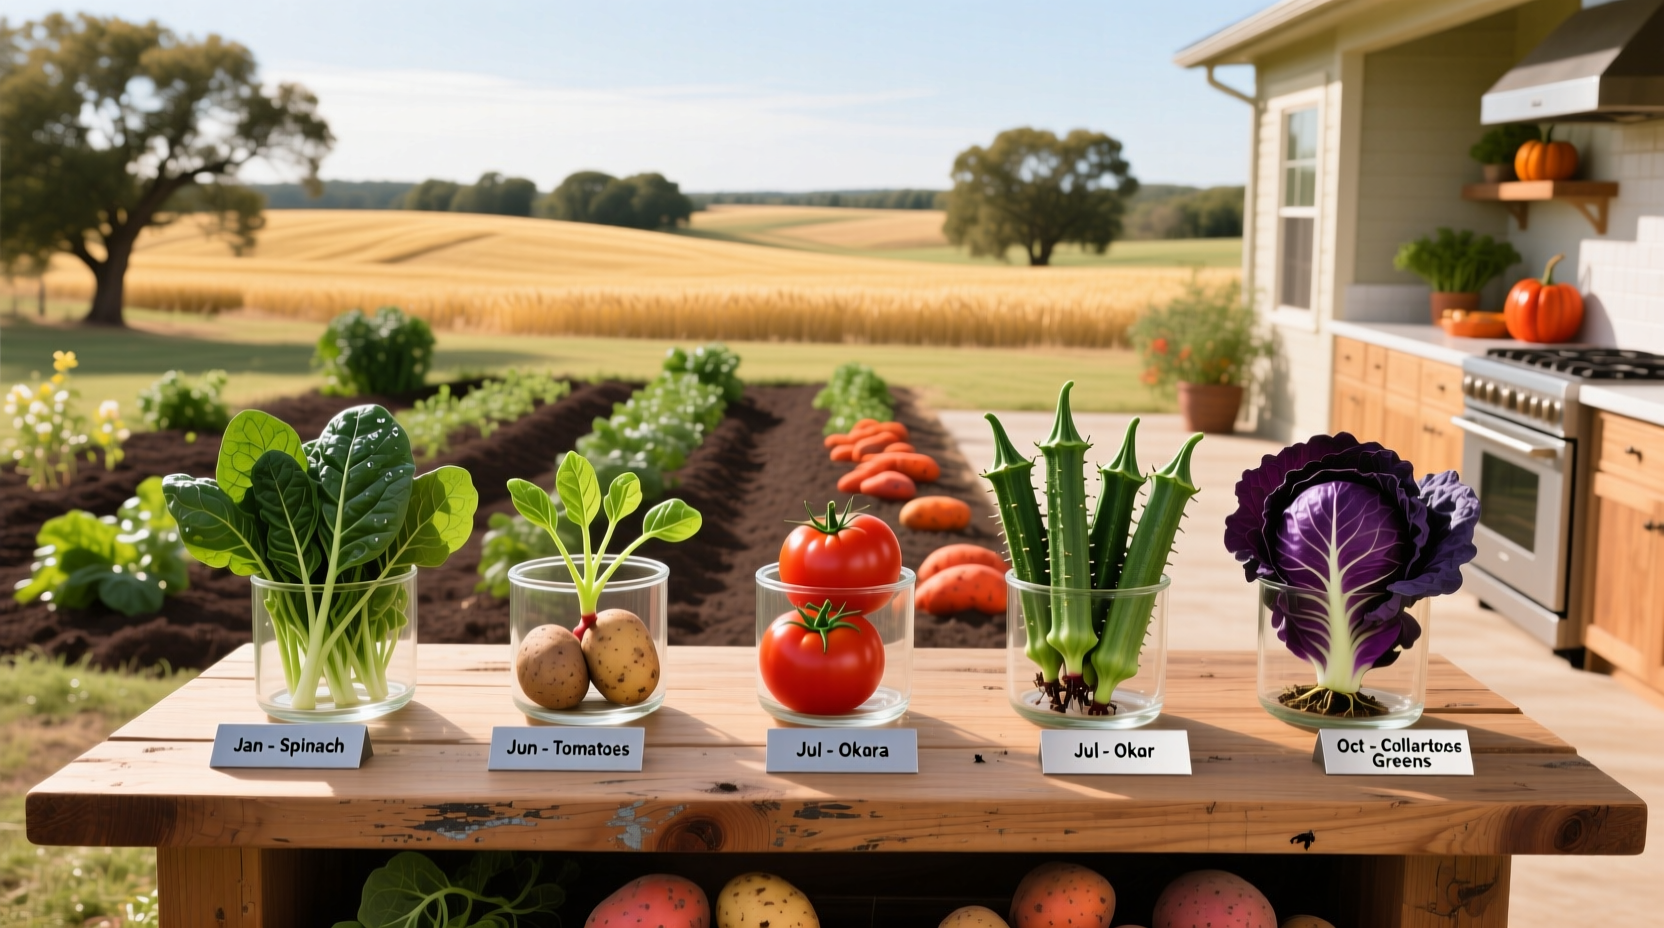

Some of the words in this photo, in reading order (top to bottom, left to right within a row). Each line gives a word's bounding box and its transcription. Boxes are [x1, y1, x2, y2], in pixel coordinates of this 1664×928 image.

[233, 737, 264, 753] Jan
[279, 736, 345, 758] Spinach
[506, 738, 538, 755] Jun
[552, 739, 630, 757] Tomatoes
[796, 741, 822, 758] Jul
[1074, 741, 1099, 759] Jul
[1114, 741, 1155, 759] Okar
[1337, 738, 1365, 754] Oct
[1372, 752, 1432, 768] Greens
